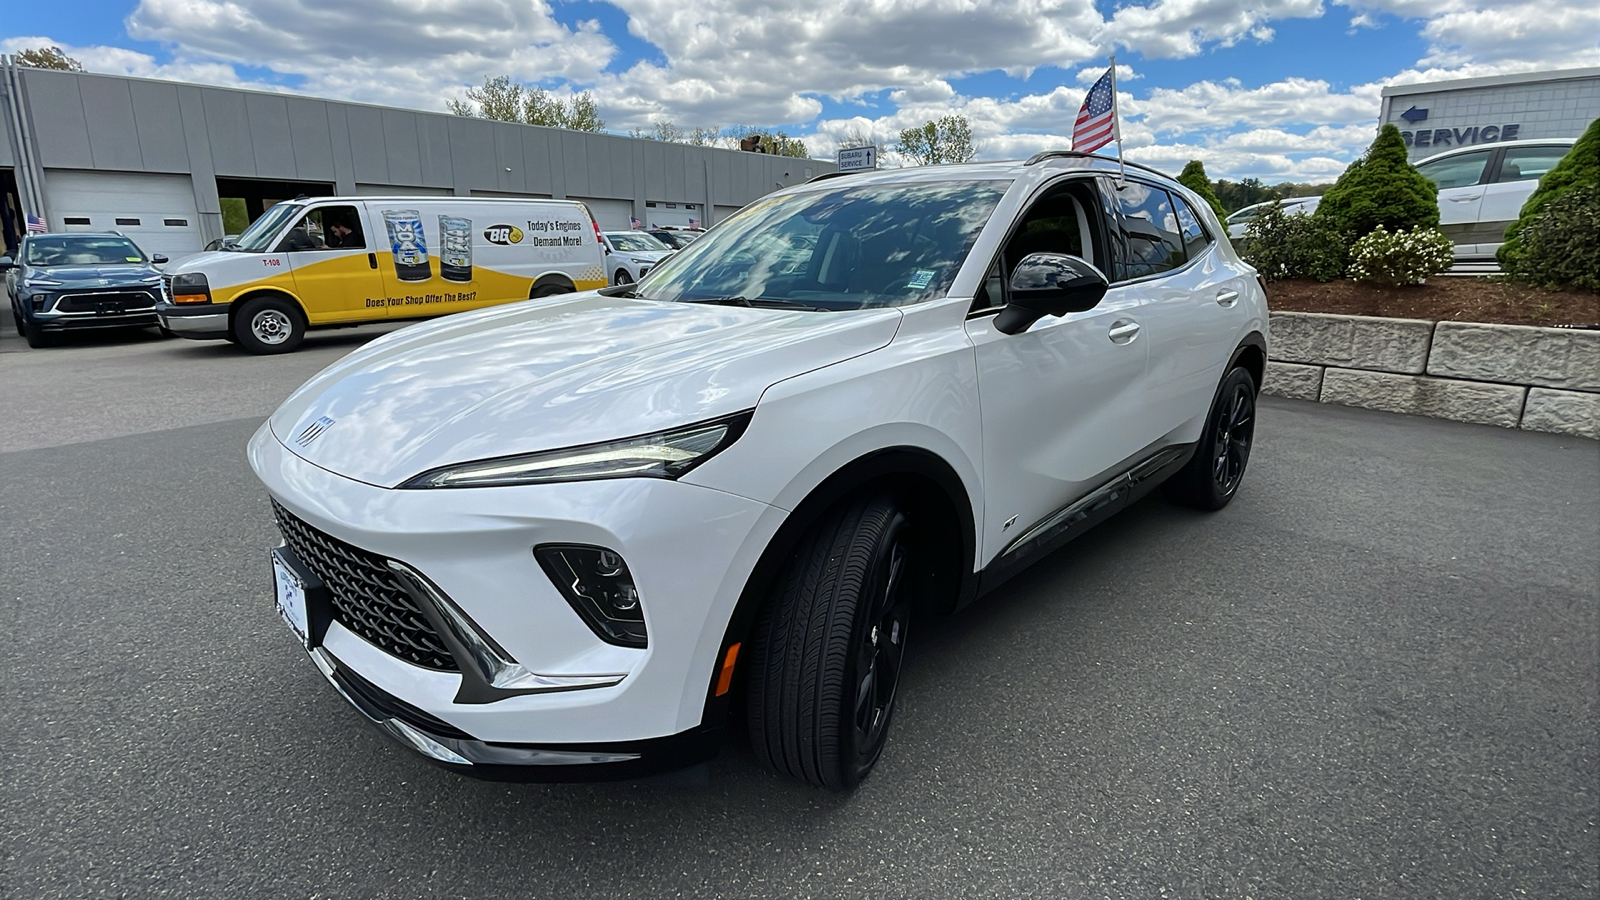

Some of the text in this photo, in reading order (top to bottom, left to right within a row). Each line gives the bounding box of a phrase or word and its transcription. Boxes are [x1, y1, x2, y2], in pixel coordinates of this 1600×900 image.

[1401, 124, 1520, 148] SERVICE
[841, 160, 862, 168] SERVICE
[527, 221, 581, 232] Today's Engines
[489, 228, 510, 242] BG
[533, 236, 582, 246] Demand More!
[365, 291, 477, 308] Does Your Shop Offer The Best?
